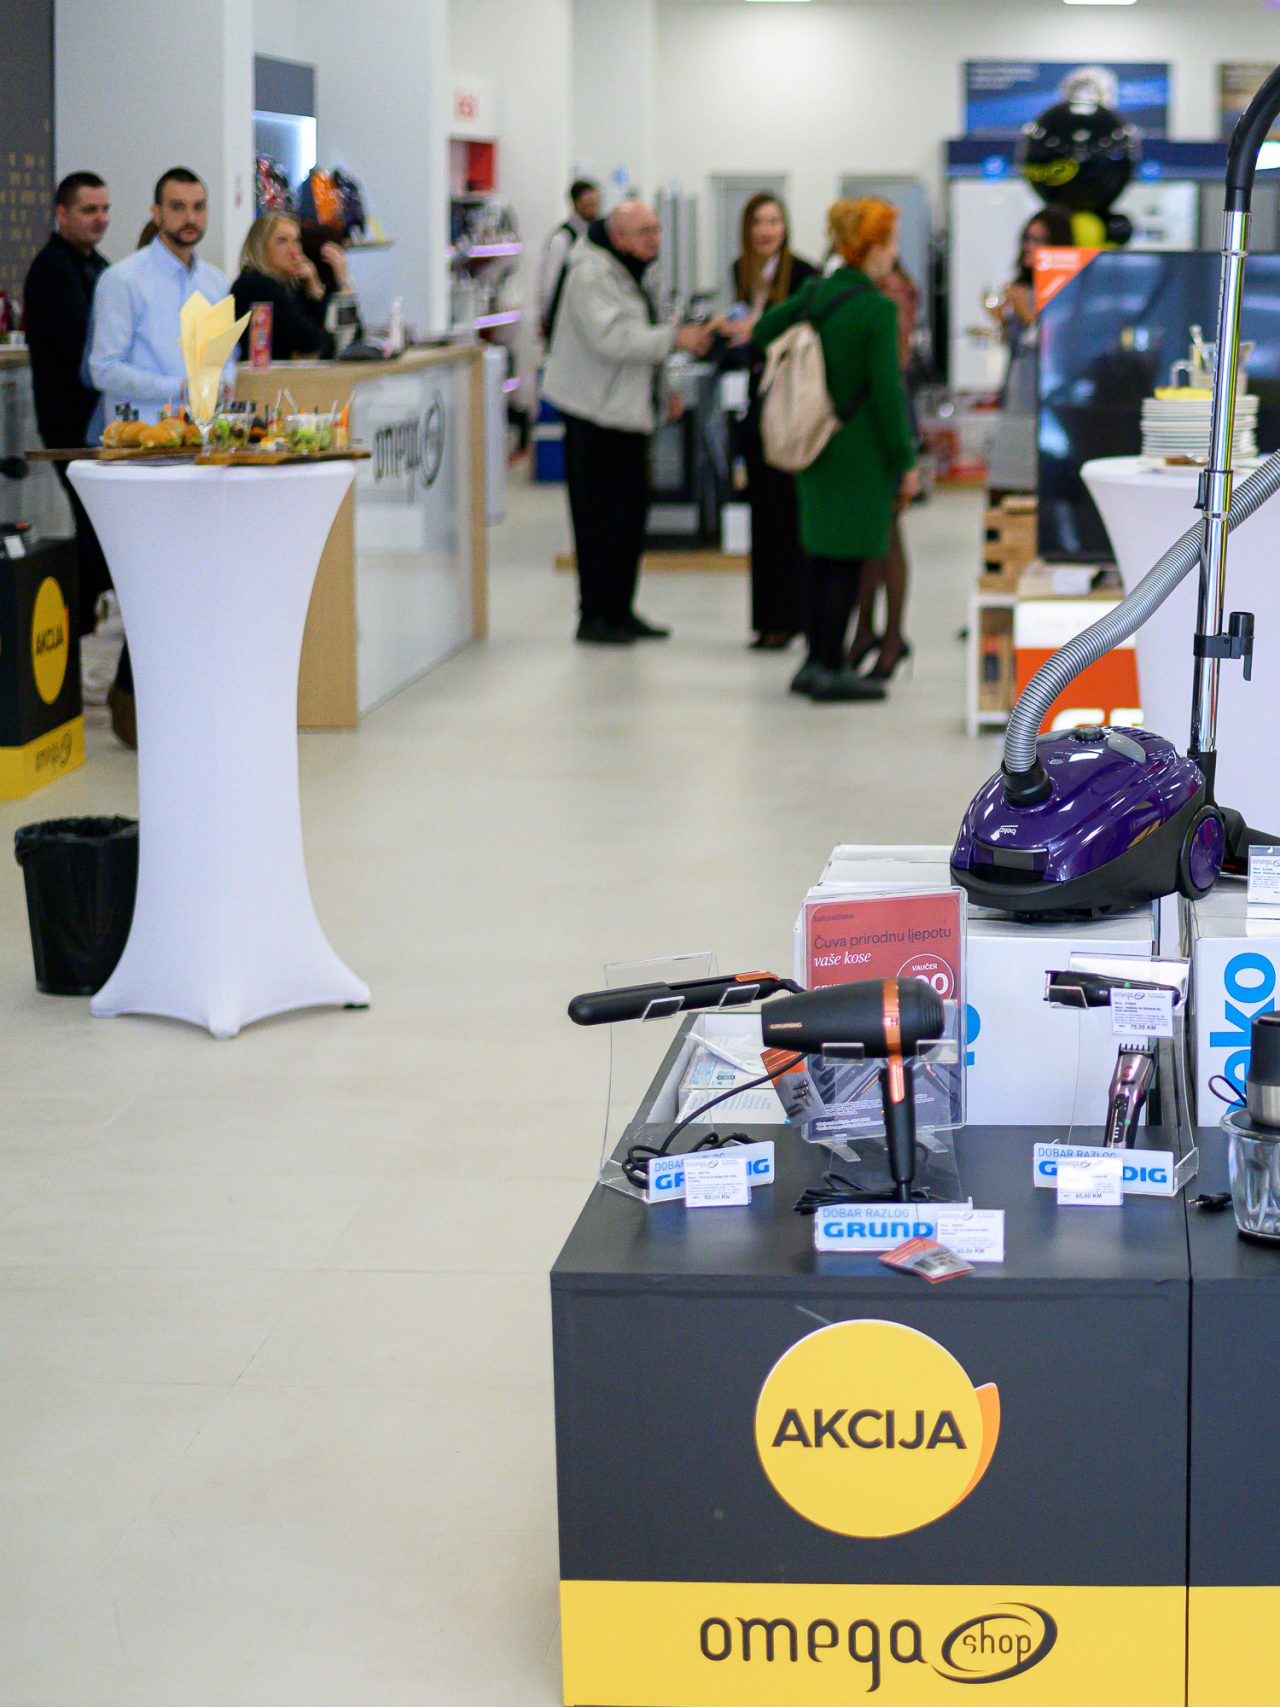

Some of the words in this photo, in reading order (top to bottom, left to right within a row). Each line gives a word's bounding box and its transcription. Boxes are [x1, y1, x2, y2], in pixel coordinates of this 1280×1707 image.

[814, 934, 847, 949] Čuva
[850, 930, 905, 948] prirodnu
[907, 927, 952, 944] ljepotu
[814, 952, 841, 967] vaše
[844, 951, 872, 964] kose
[912, 963, 938, 971] VAUČER
[1038, 1147, 1074, 1158] DOBAR
[823, 1208, 862, 1218] DOBAR
[866, 1208, 910, 1218] RAZLOG
[772, 1409, 967, 1449] AKCIJA
[700, 1616, 927, 1693] omega
[963, 1620, 1032, 1671] shop
